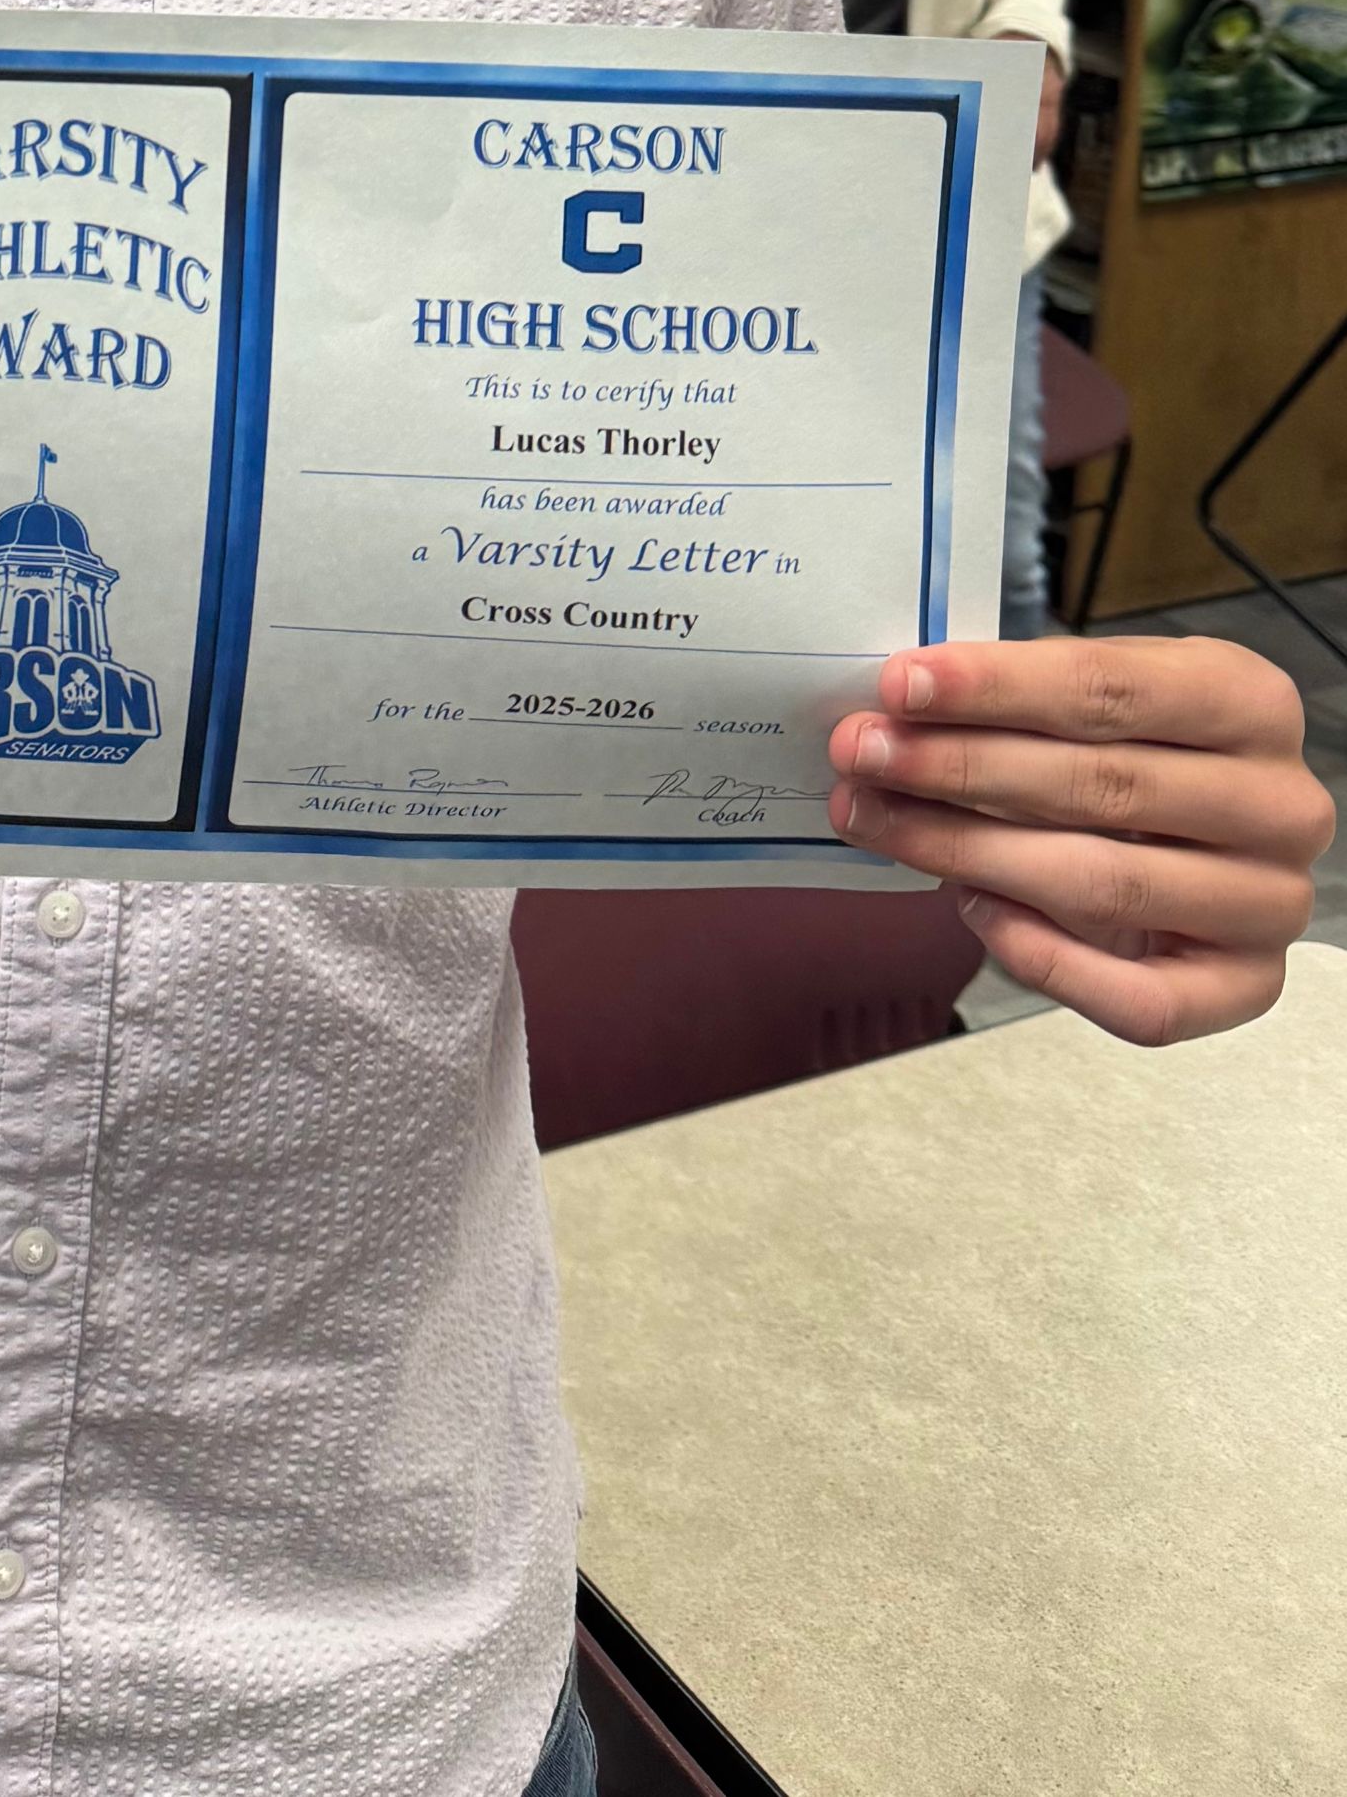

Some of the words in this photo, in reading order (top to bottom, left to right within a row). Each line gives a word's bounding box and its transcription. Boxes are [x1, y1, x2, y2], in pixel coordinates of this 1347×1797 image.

[474, 119, 726, 176] CARSON
[562, 190, 645, 274] C
[412, 299, 565, 351] HIGH
[582, 304, 818, 355] SCHOOL
[465, 373, 521, 400] This
[531, 377, 552, 400] is
[561, 380, 587, 402] to
[595, 378, 674, 411] cerify
[683, 379, 738, 404] that
[491, 425, 586, 454] Lucas
[598, 427, 722, 464] Thorley
[479, 486, 526, 511] has
[534, 487, 597, 513] been
[605, 491, 732, 516] awarded
[411, 545, 429, 564] a
[440, 526, 614, 582] Varsity
[628, 538, 770, 575] Letter
[775, 552, 801, 575] in
[460, 596, 553, 625] Cross
[563, 601, 700, 638] Country
[366, 699, 418, 724] for
[424, 701, 466, 722] the
[505, 693, 655, 721] 2025-2026
[693, 717, 786, 736] season.
[5, 740, 130, 761] SENATORS
[299, 795, 396, 817] Athletic
[405, 800, 509, 820] Director
[697, 807, 767, 823] Coach
